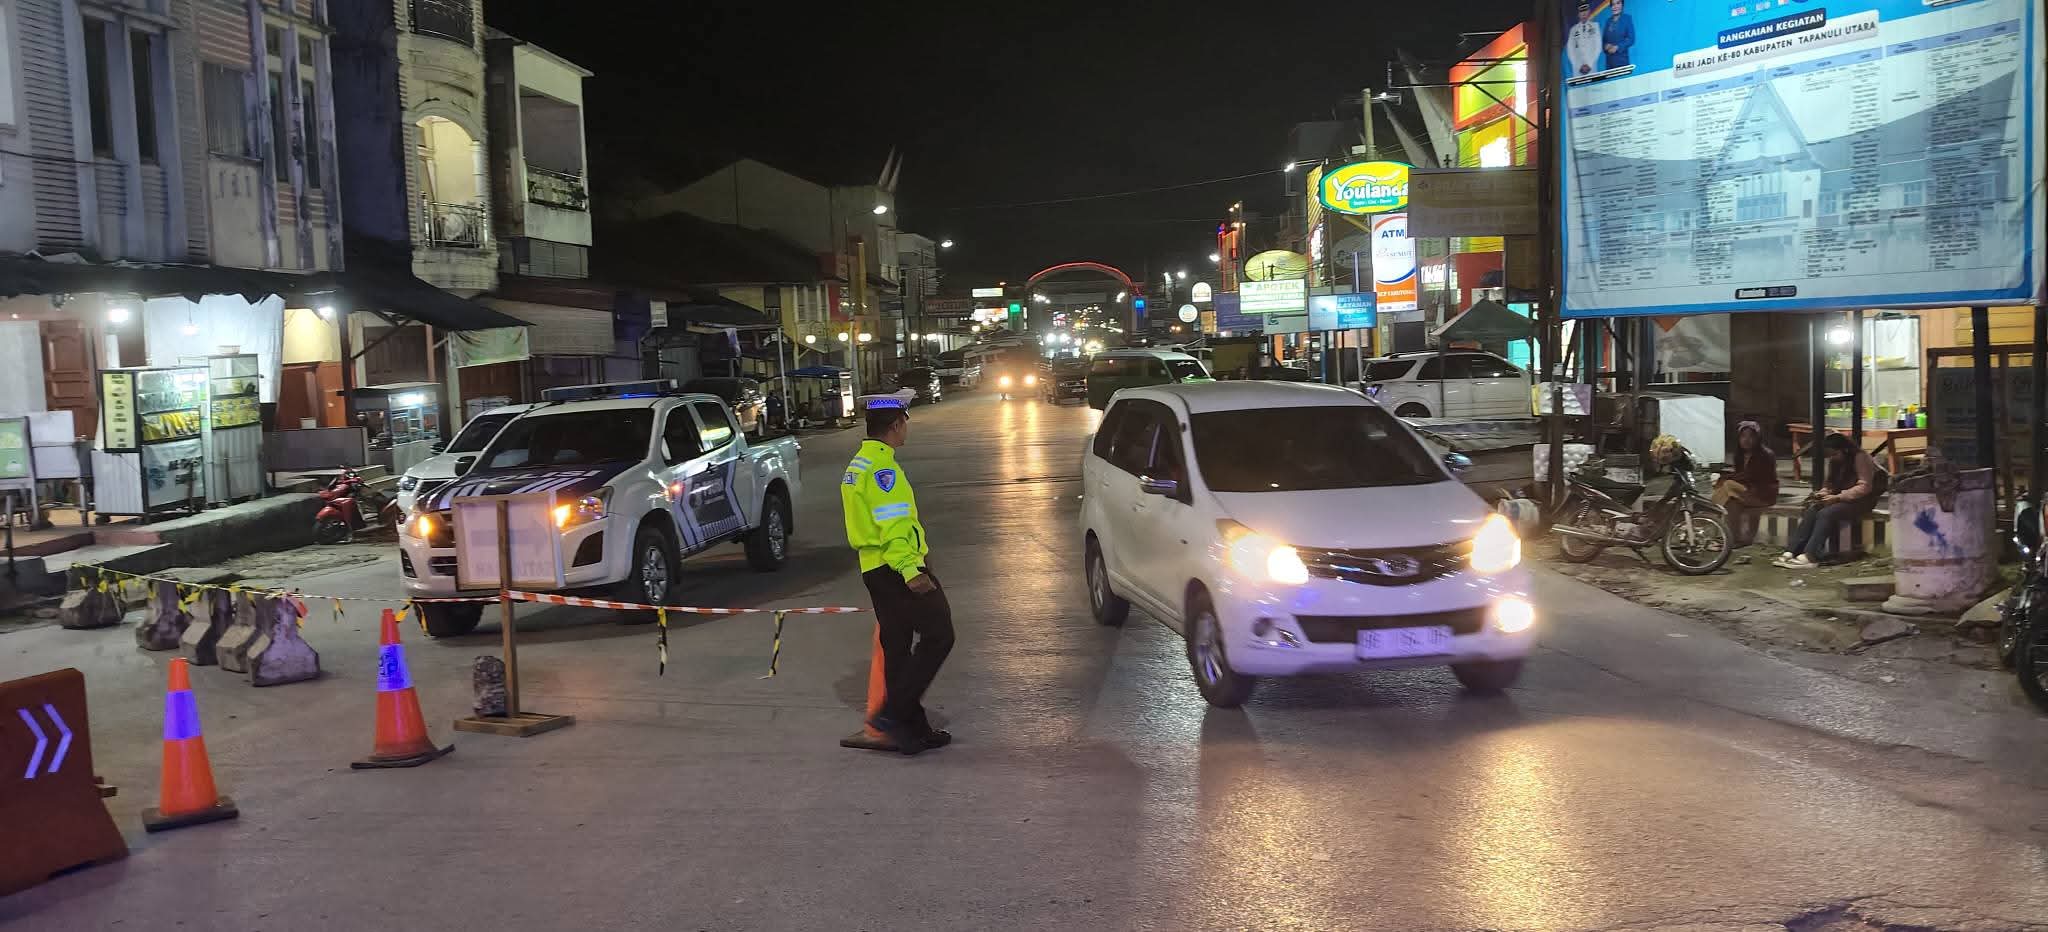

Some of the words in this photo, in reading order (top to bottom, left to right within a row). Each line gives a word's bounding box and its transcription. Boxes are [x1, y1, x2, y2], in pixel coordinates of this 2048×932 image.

[1719, 27, 1773, 44] RANGKAIAN
[1776, 13, 1824, 31] KEGIATAN
[1675, 61, 1695, 71] HARI
[1697, 56, 1715, 68] JADI
[1717, 51, 1741, 63] KE-80
[1743, 38, 1793, 56] KABUPATEN
[1798, 28, 1842, 44] TAPANULI
[1845, 21, 1876, 35] UTARA
[1381, 228, 1405, 239] ATM
